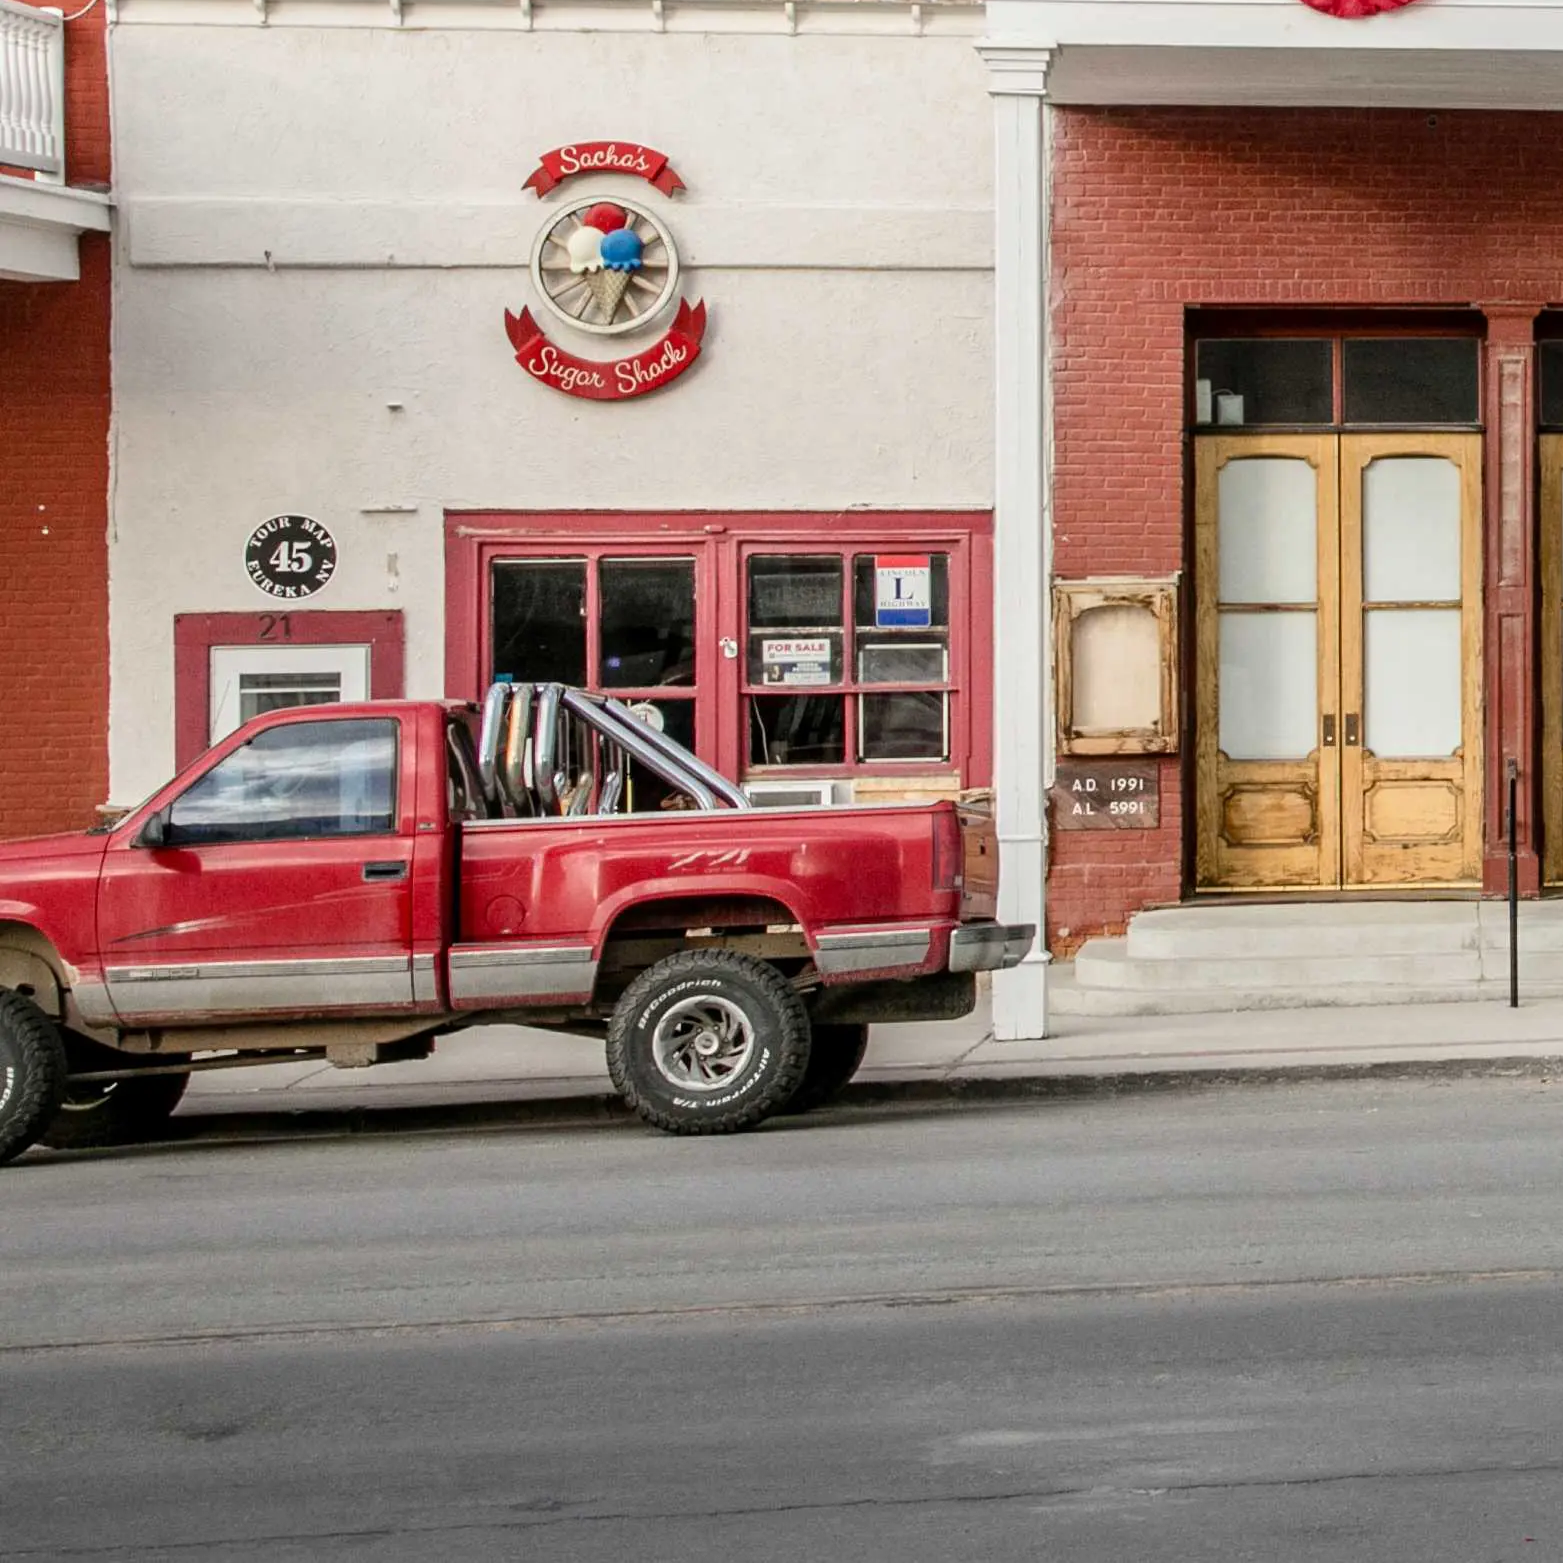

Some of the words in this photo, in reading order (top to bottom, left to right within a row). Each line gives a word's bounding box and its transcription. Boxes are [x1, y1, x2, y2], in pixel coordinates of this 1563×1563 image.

[560, 144, 650, 174] Sacha's
[528, 346, 604, 391] Sugar
[615, 340, 687, 394] Shack
[249, 517, 292, 548] TOUR
[301, 518, 333, 549] MAP
[269, 540, 313, 573] 45
[247, 560, 311, 598] EUREKA
[315, 559, 334, 582] NV
[893, 577, 914, 600] L
[258, 613, 292, 641] 21
[767, 643, 792, 652] FOR
[795, 643, 826, 652] SALE
[1110, 777, 1144, 791] 1991
[1109, 801, 1144, 815] 5991
[637, 979, 723, 1030] BFGoodrich
